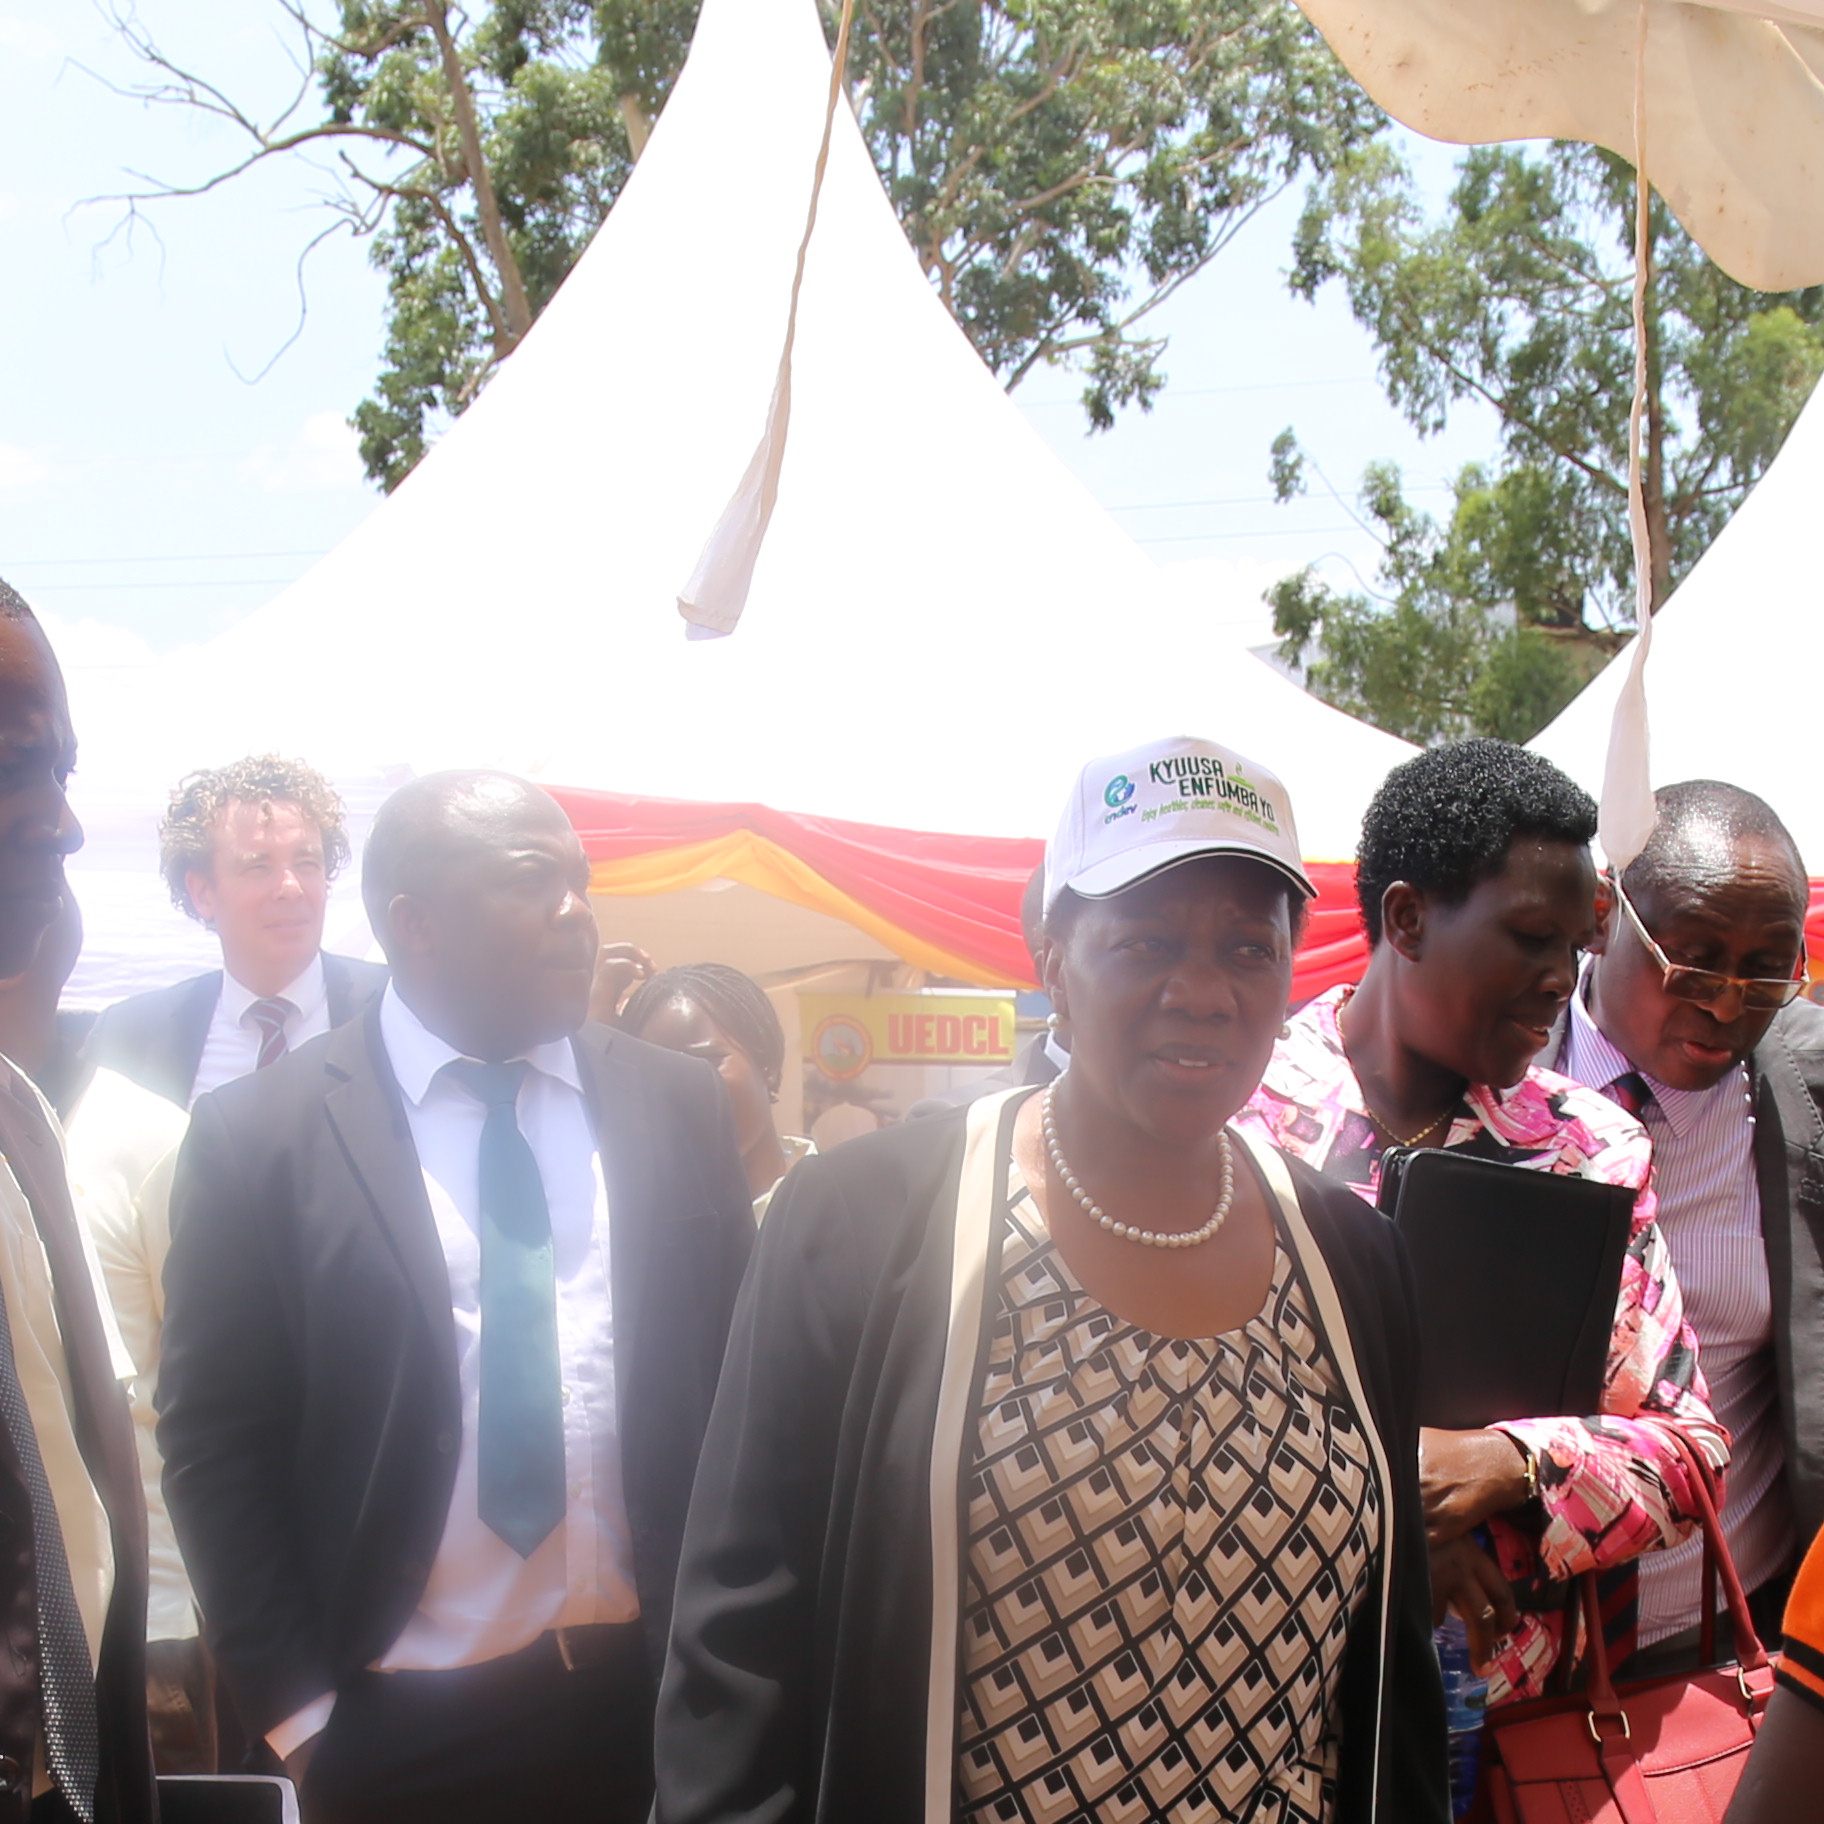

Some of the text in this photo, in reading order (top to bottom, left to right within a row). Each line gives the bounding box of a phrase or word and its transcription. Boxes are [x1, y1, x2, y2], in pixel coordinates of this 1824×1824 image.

[1150, 757, 1223, 784] KYUUSA
[1179, 776, 1258, 812] ENFUMBA
[888, 1013, 1010, 1056] UEDCL
